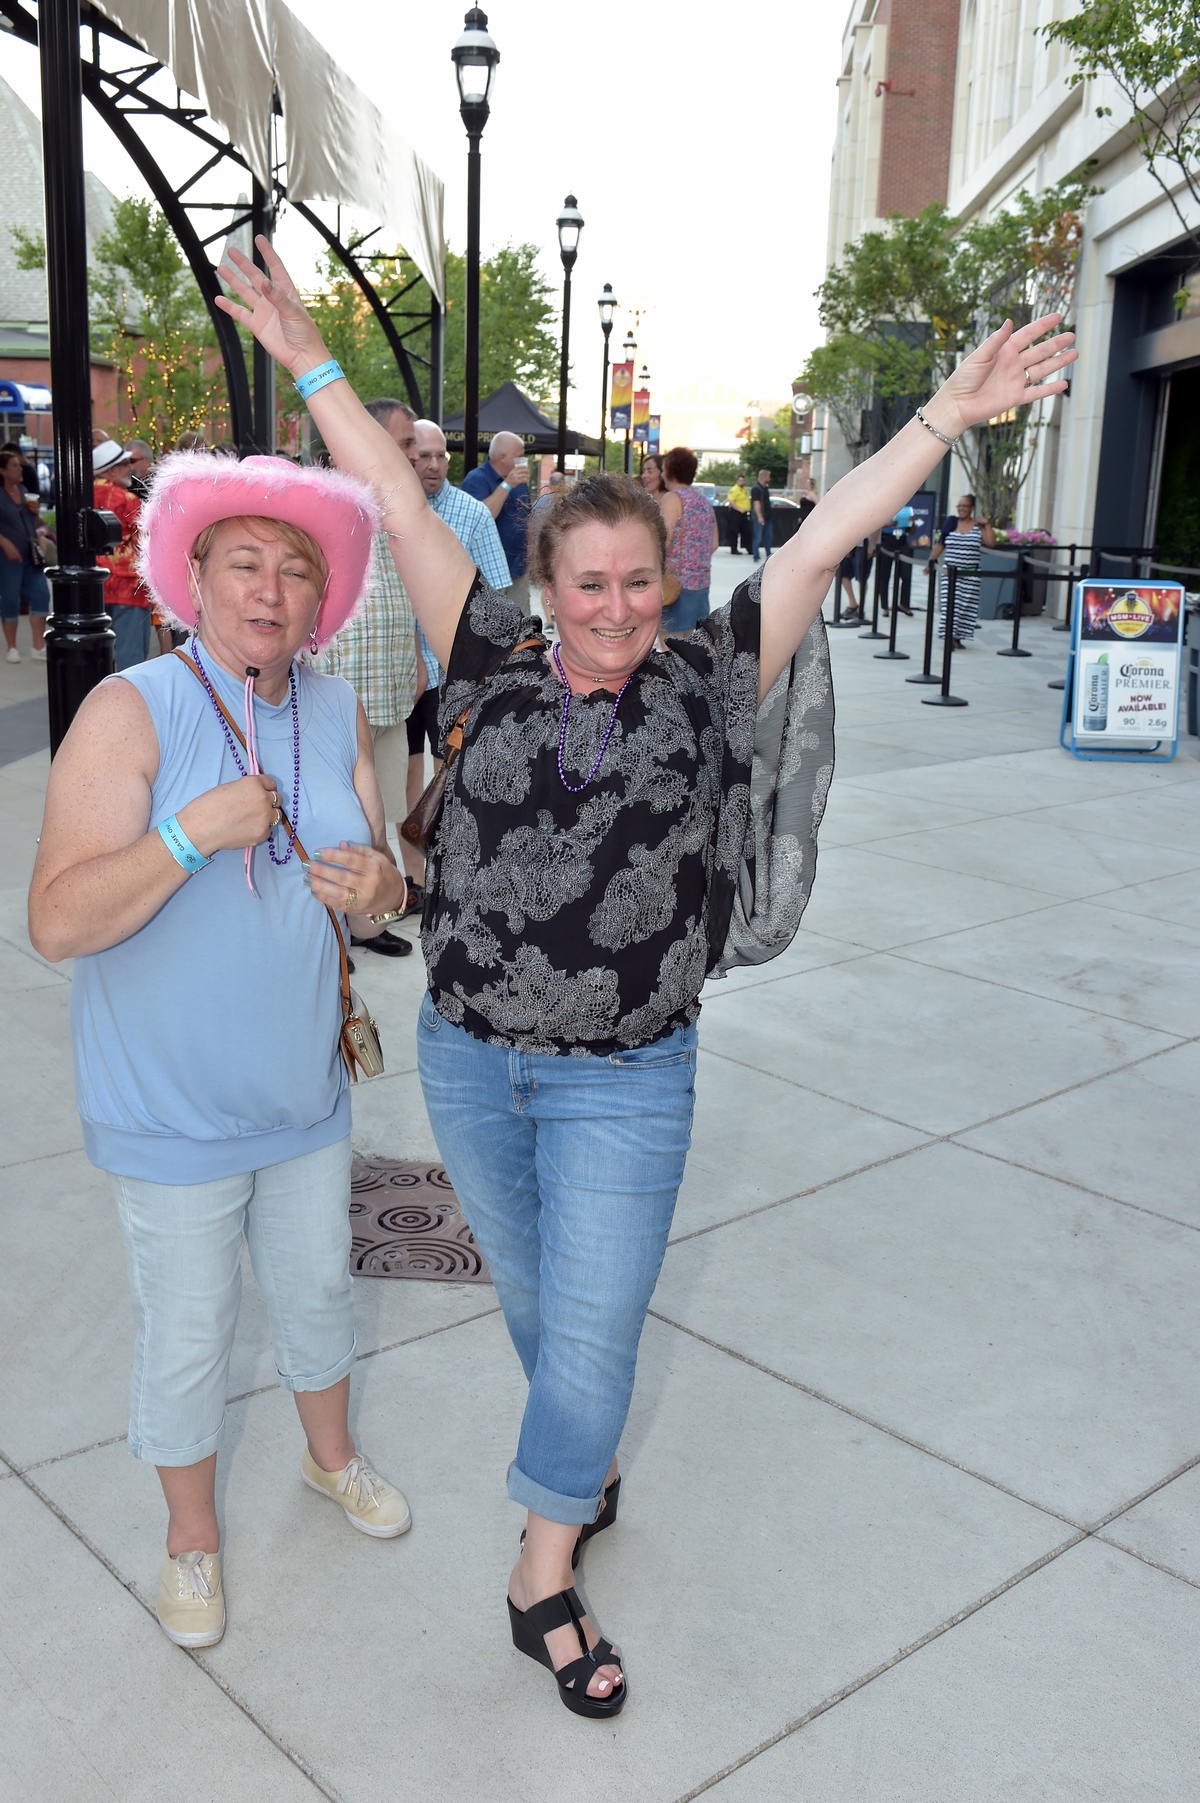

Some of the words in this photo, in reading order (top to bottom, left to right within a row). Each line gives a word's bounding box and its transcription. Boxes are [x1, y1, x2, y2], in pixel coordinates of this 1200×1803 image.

[318, 368, 334, 379] GAME
[307, 377, 317, 386] ON!
[1132, 614, 1150, 622] LIVE
[1120, 663, 1164, 679] Corona
[1115, 678, 1170, 690] PREMIER
[1089, 674, 1099, 712] Corona
[1130, 694, 1152, 703] NOW
[1118, 703, 1166, 713] AVAILABLE!
[1123, 717, 1136, 726] 90
[1147, 718, 1167, 728] 2.6g
[171, 833, 185, 851] GAME
